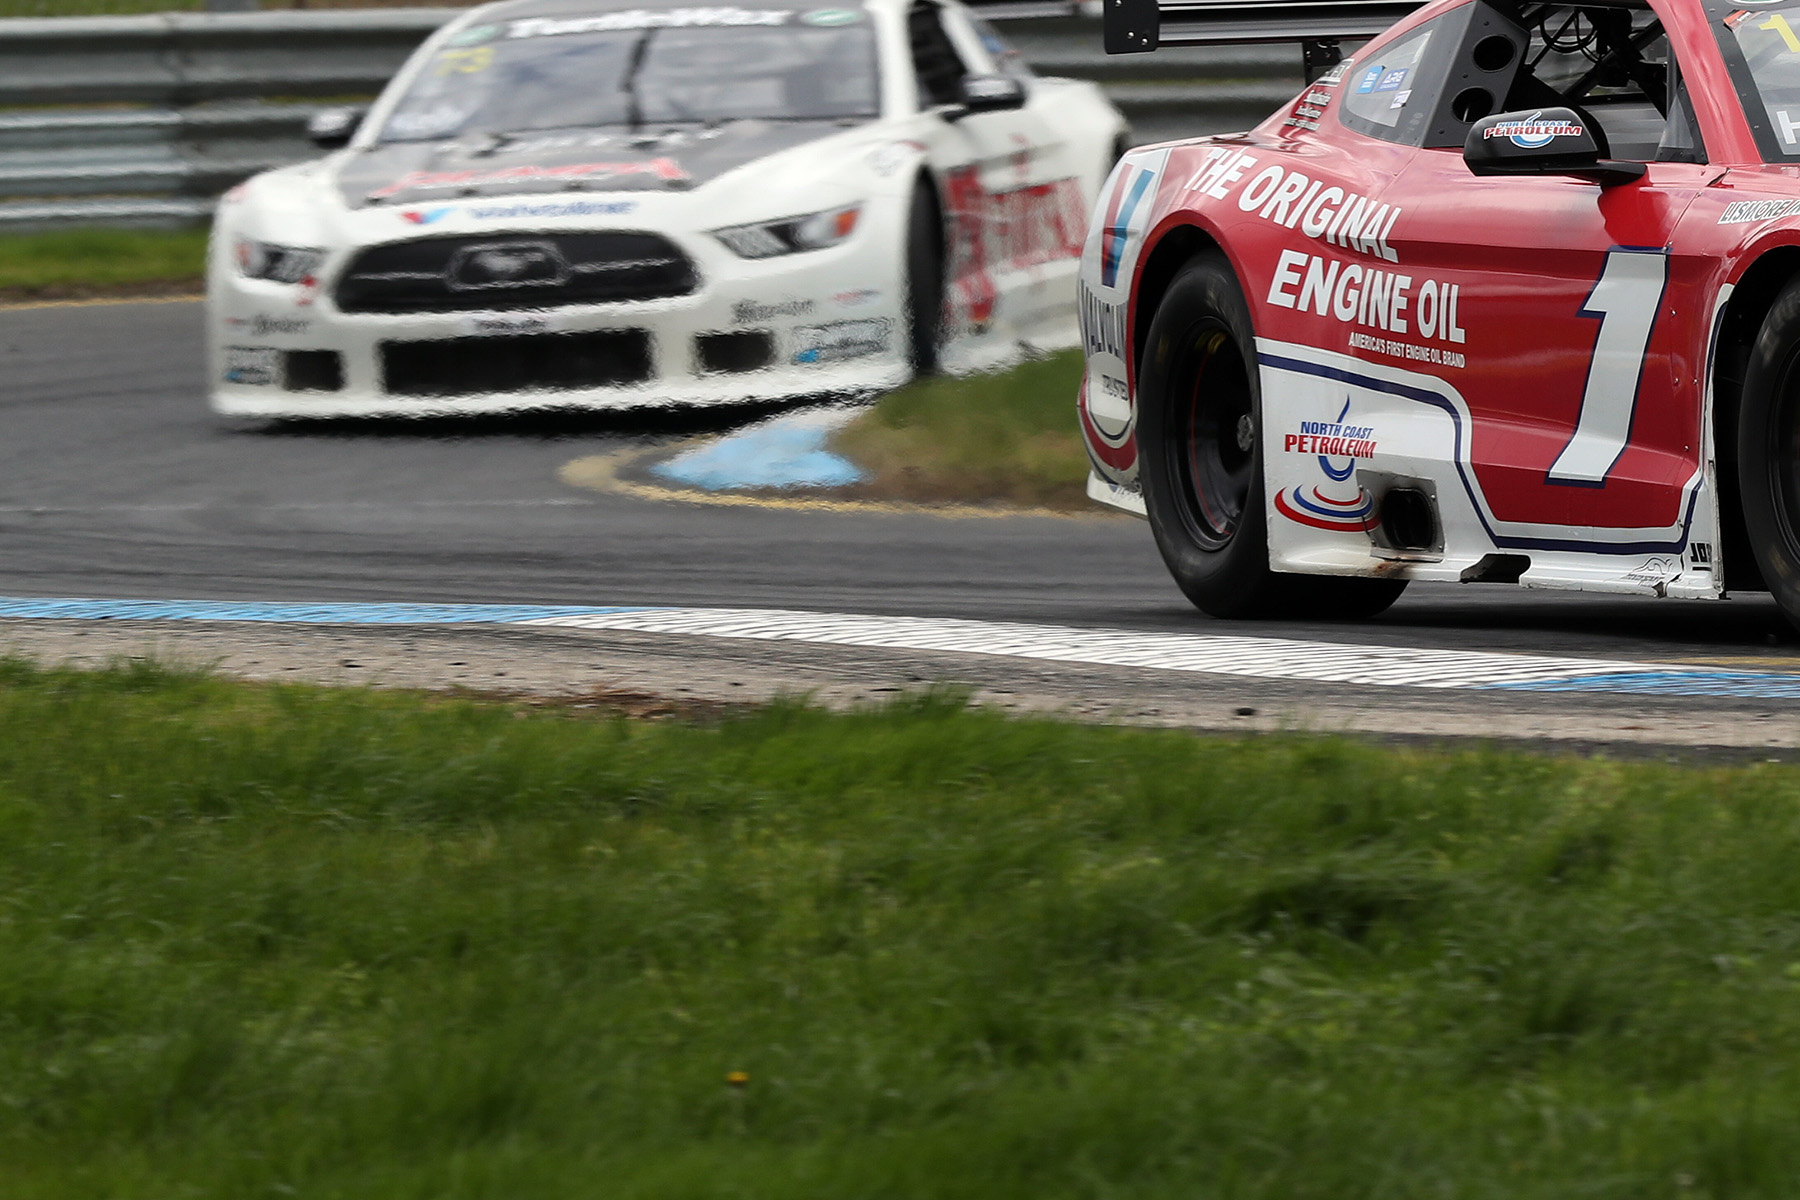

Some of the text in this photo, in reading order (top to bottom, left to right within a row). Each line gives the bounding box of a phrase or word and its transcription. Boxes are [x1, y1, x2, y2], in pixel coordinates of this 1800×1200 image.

[1484, 126, 1582, 139] PETROLEUM
[1184, 146, 1402, 264] THE ORIGINAL
[1717, 200, 1793, 225] LISMORE
[1266, 248, 1466, 344] ENGINE OIL
[1348, 331, 1466, 369] AMERICA'S FIRST ENGINE OIL BRAND
[1546, 246, 1670, 487] 1
[1284, 433, 1378, 459] PETROLEUM
[1300, 421, 1373, 440] NORTH COAST
